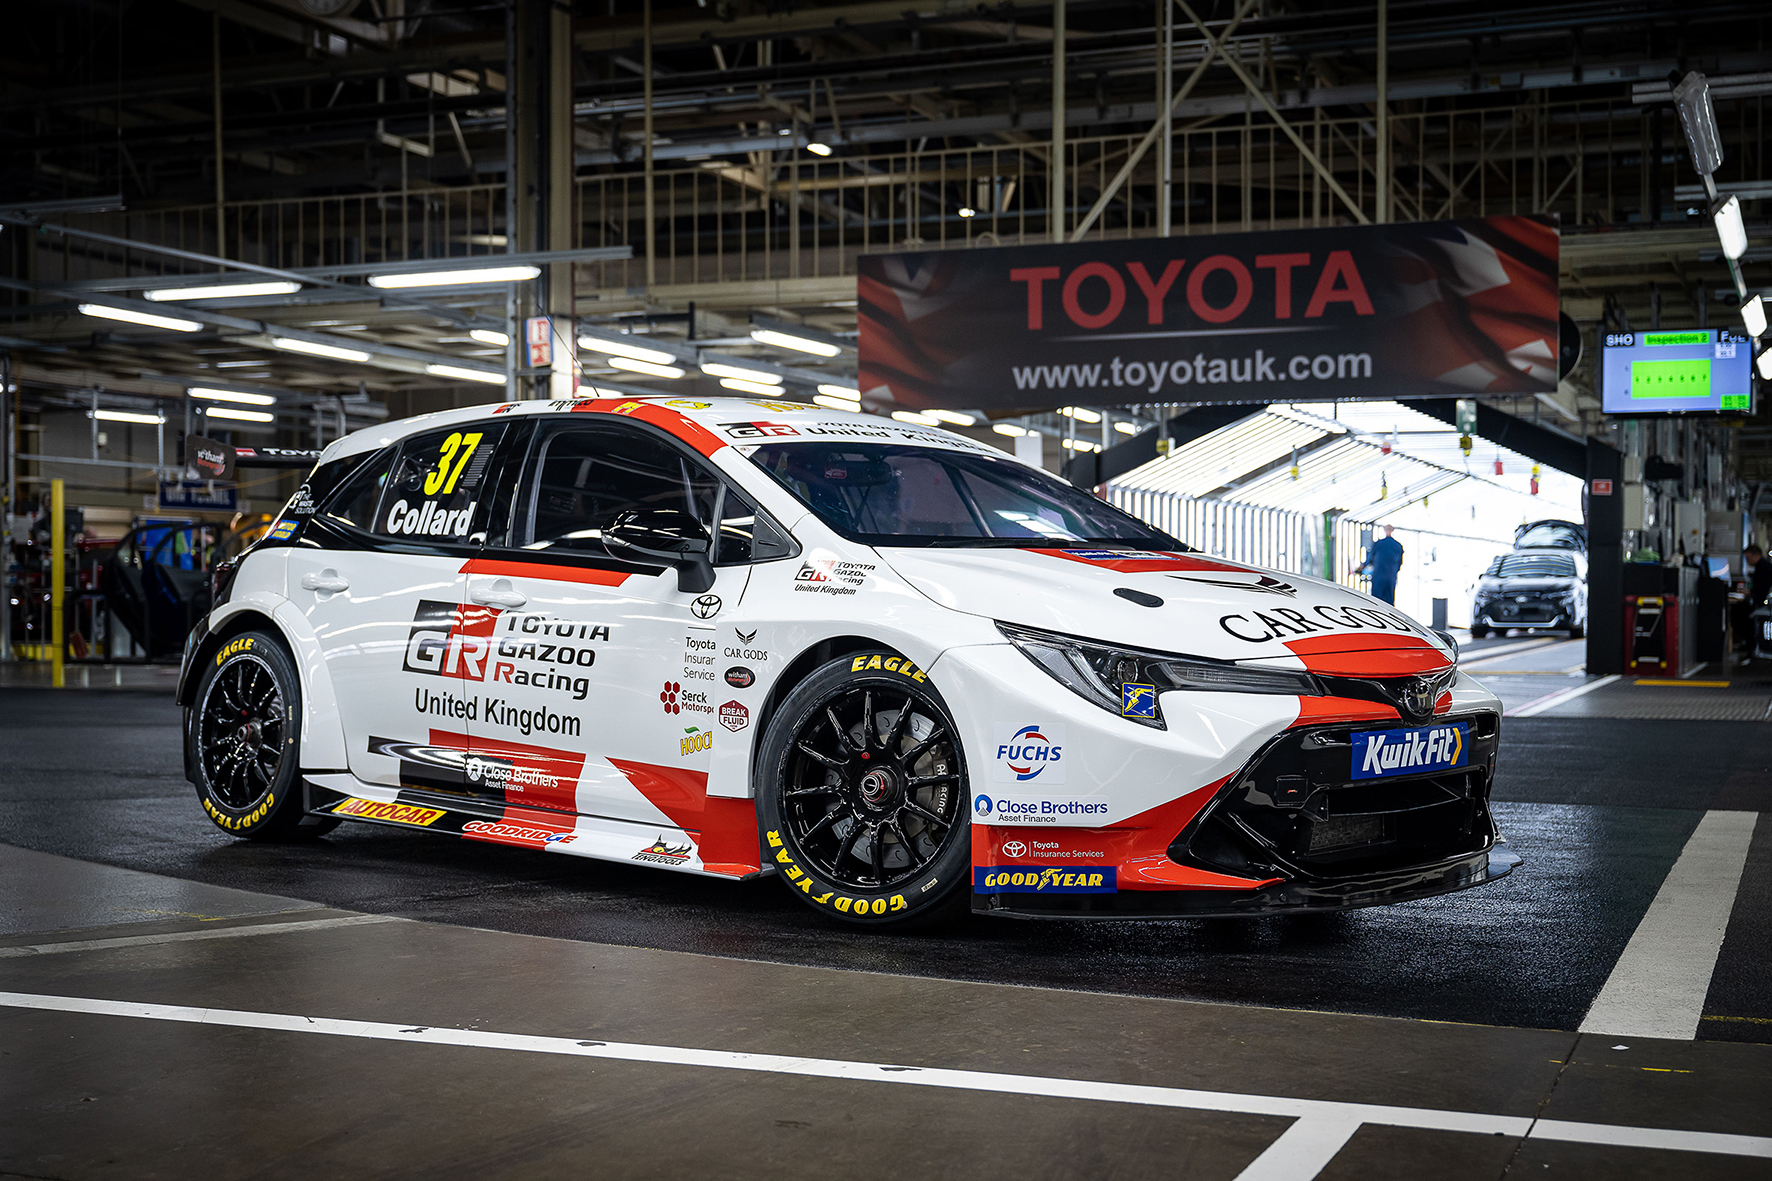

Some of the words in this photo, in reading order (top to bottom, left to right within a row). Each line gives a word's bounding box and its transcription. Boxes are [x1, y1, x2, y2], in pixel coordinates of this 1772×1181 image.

[1010, 250, 1375, 330] TOYOTA
[1012, 350, 1373, 393] www.toyotauk.com
[805, 427, 892, 438] United
[424, 432, 483, 496] 37
[387, 499, 477, 536] Collard
[838, 561, 876, 571] TOYOTA
[794, 584, 821, 593] United
[820, 585, 857, 596] Kingdom
[505, 610, 610, 642] TOYOTA
[1219, 607, 1334, 643] CAR
[216, 637, 255, 667] EAGLE
[406, 629, 488, 678] GR
[499, 637, 596, 667] GAZOO
[686, 637, 716, 651] Toyota
[724, 647, 742, 659] CAR
[743, 649, 768, 661] GODS
[493, 662, 590, 701] Racing
[683, 667, 716, 681] Service
[850, 655, 928, 685] EAGLE
[681, 690, 708, 704] Serck
[415, 687, 478, 721] United
[484, 697, 581, 737] Kingdom
[721, 706, 746, 717] BREAK
[723, 716, 745, 726] FLUID
[996, 744, 1062, 761] FUCHS
[484, 764, 512, 781] Close
[513, 767, 559, 788] Brothers
[484, 779, 501, 789] Asset
[501, 780, 524, 792] Finance
[936, 783, 948, 815] ACING
[996, 800, 1038, 814] Close
[1041, 800, 1108, 814] Brothers
[342, 800, 438, 826] AUTOCAR
[998, 814, 1022, 823] Asset
[1023, 814, 1057, 823] Finance
[461, 820, 579, 845] GOODRIDGE
[1033, 841, 1059, 850] Toyota
[1033, 850, 1071, 858] Insurance
[1072, 850, 1105, 858] Services
